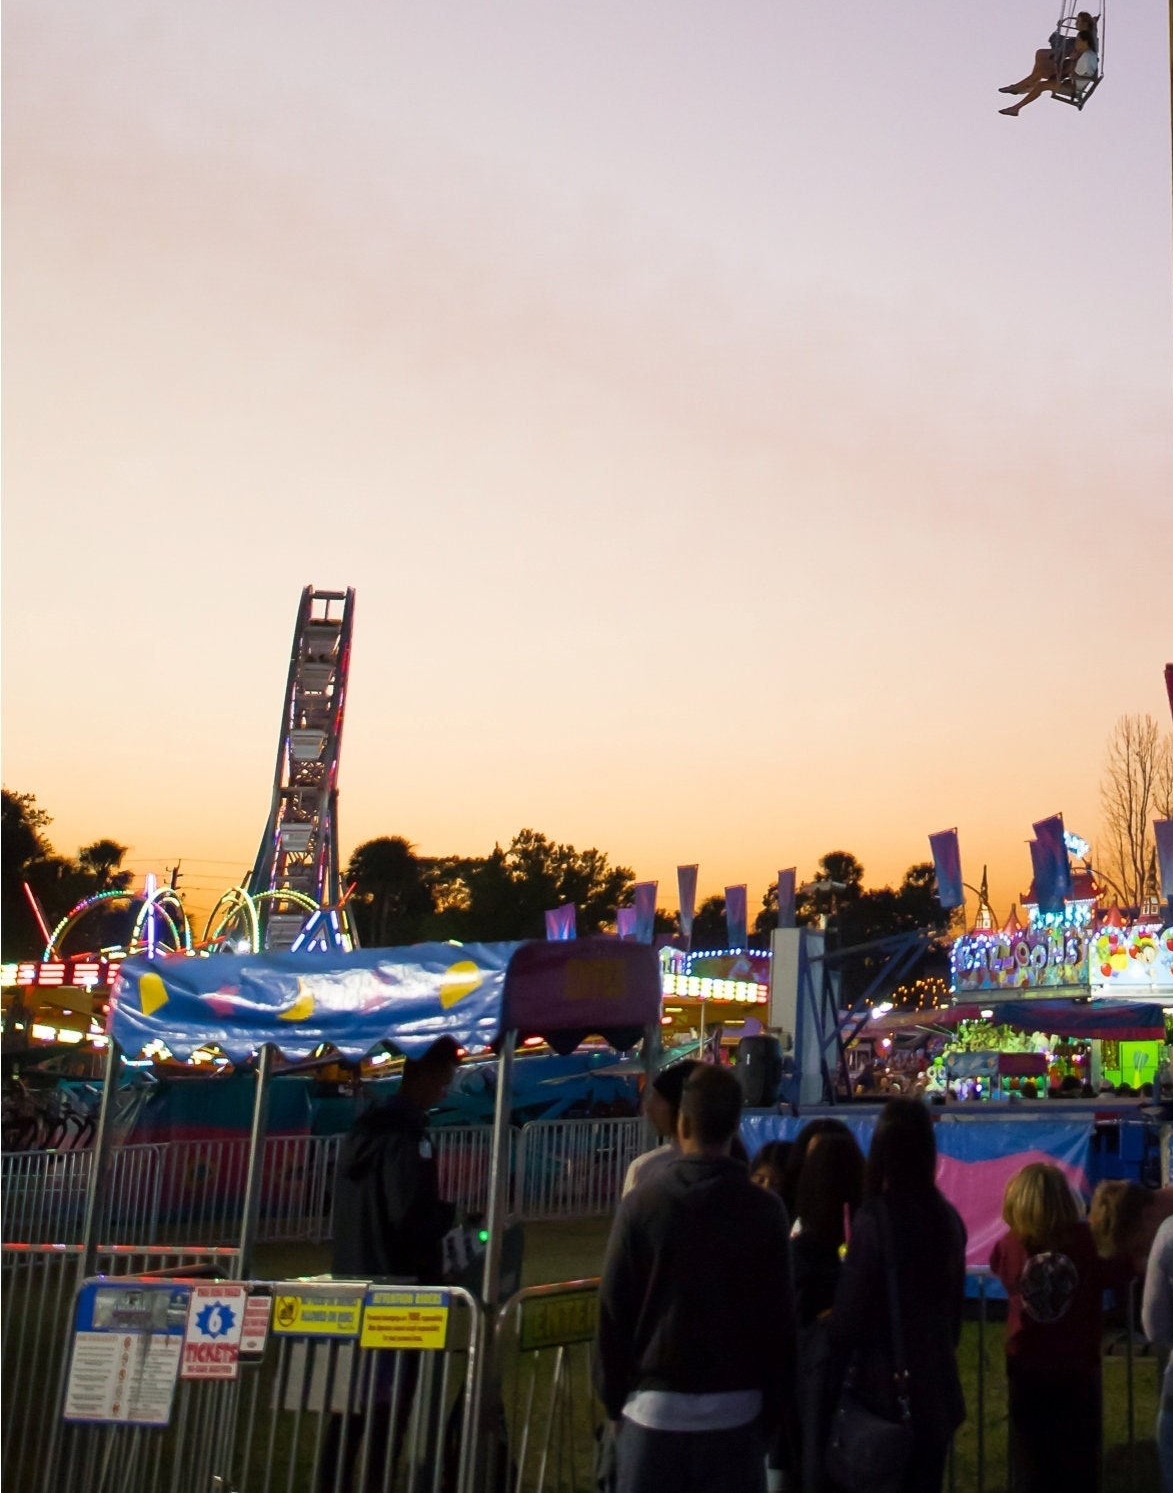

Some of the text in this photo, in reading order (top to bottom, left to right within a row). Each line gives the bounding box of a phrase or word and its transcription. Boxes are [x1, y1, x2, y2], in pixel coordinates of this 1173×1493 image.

[956, 938, 1079, 971] BALLOONS
[208, 1306, 223, 1333] 6
[186, 1343, 239, 1363] TICKETS
